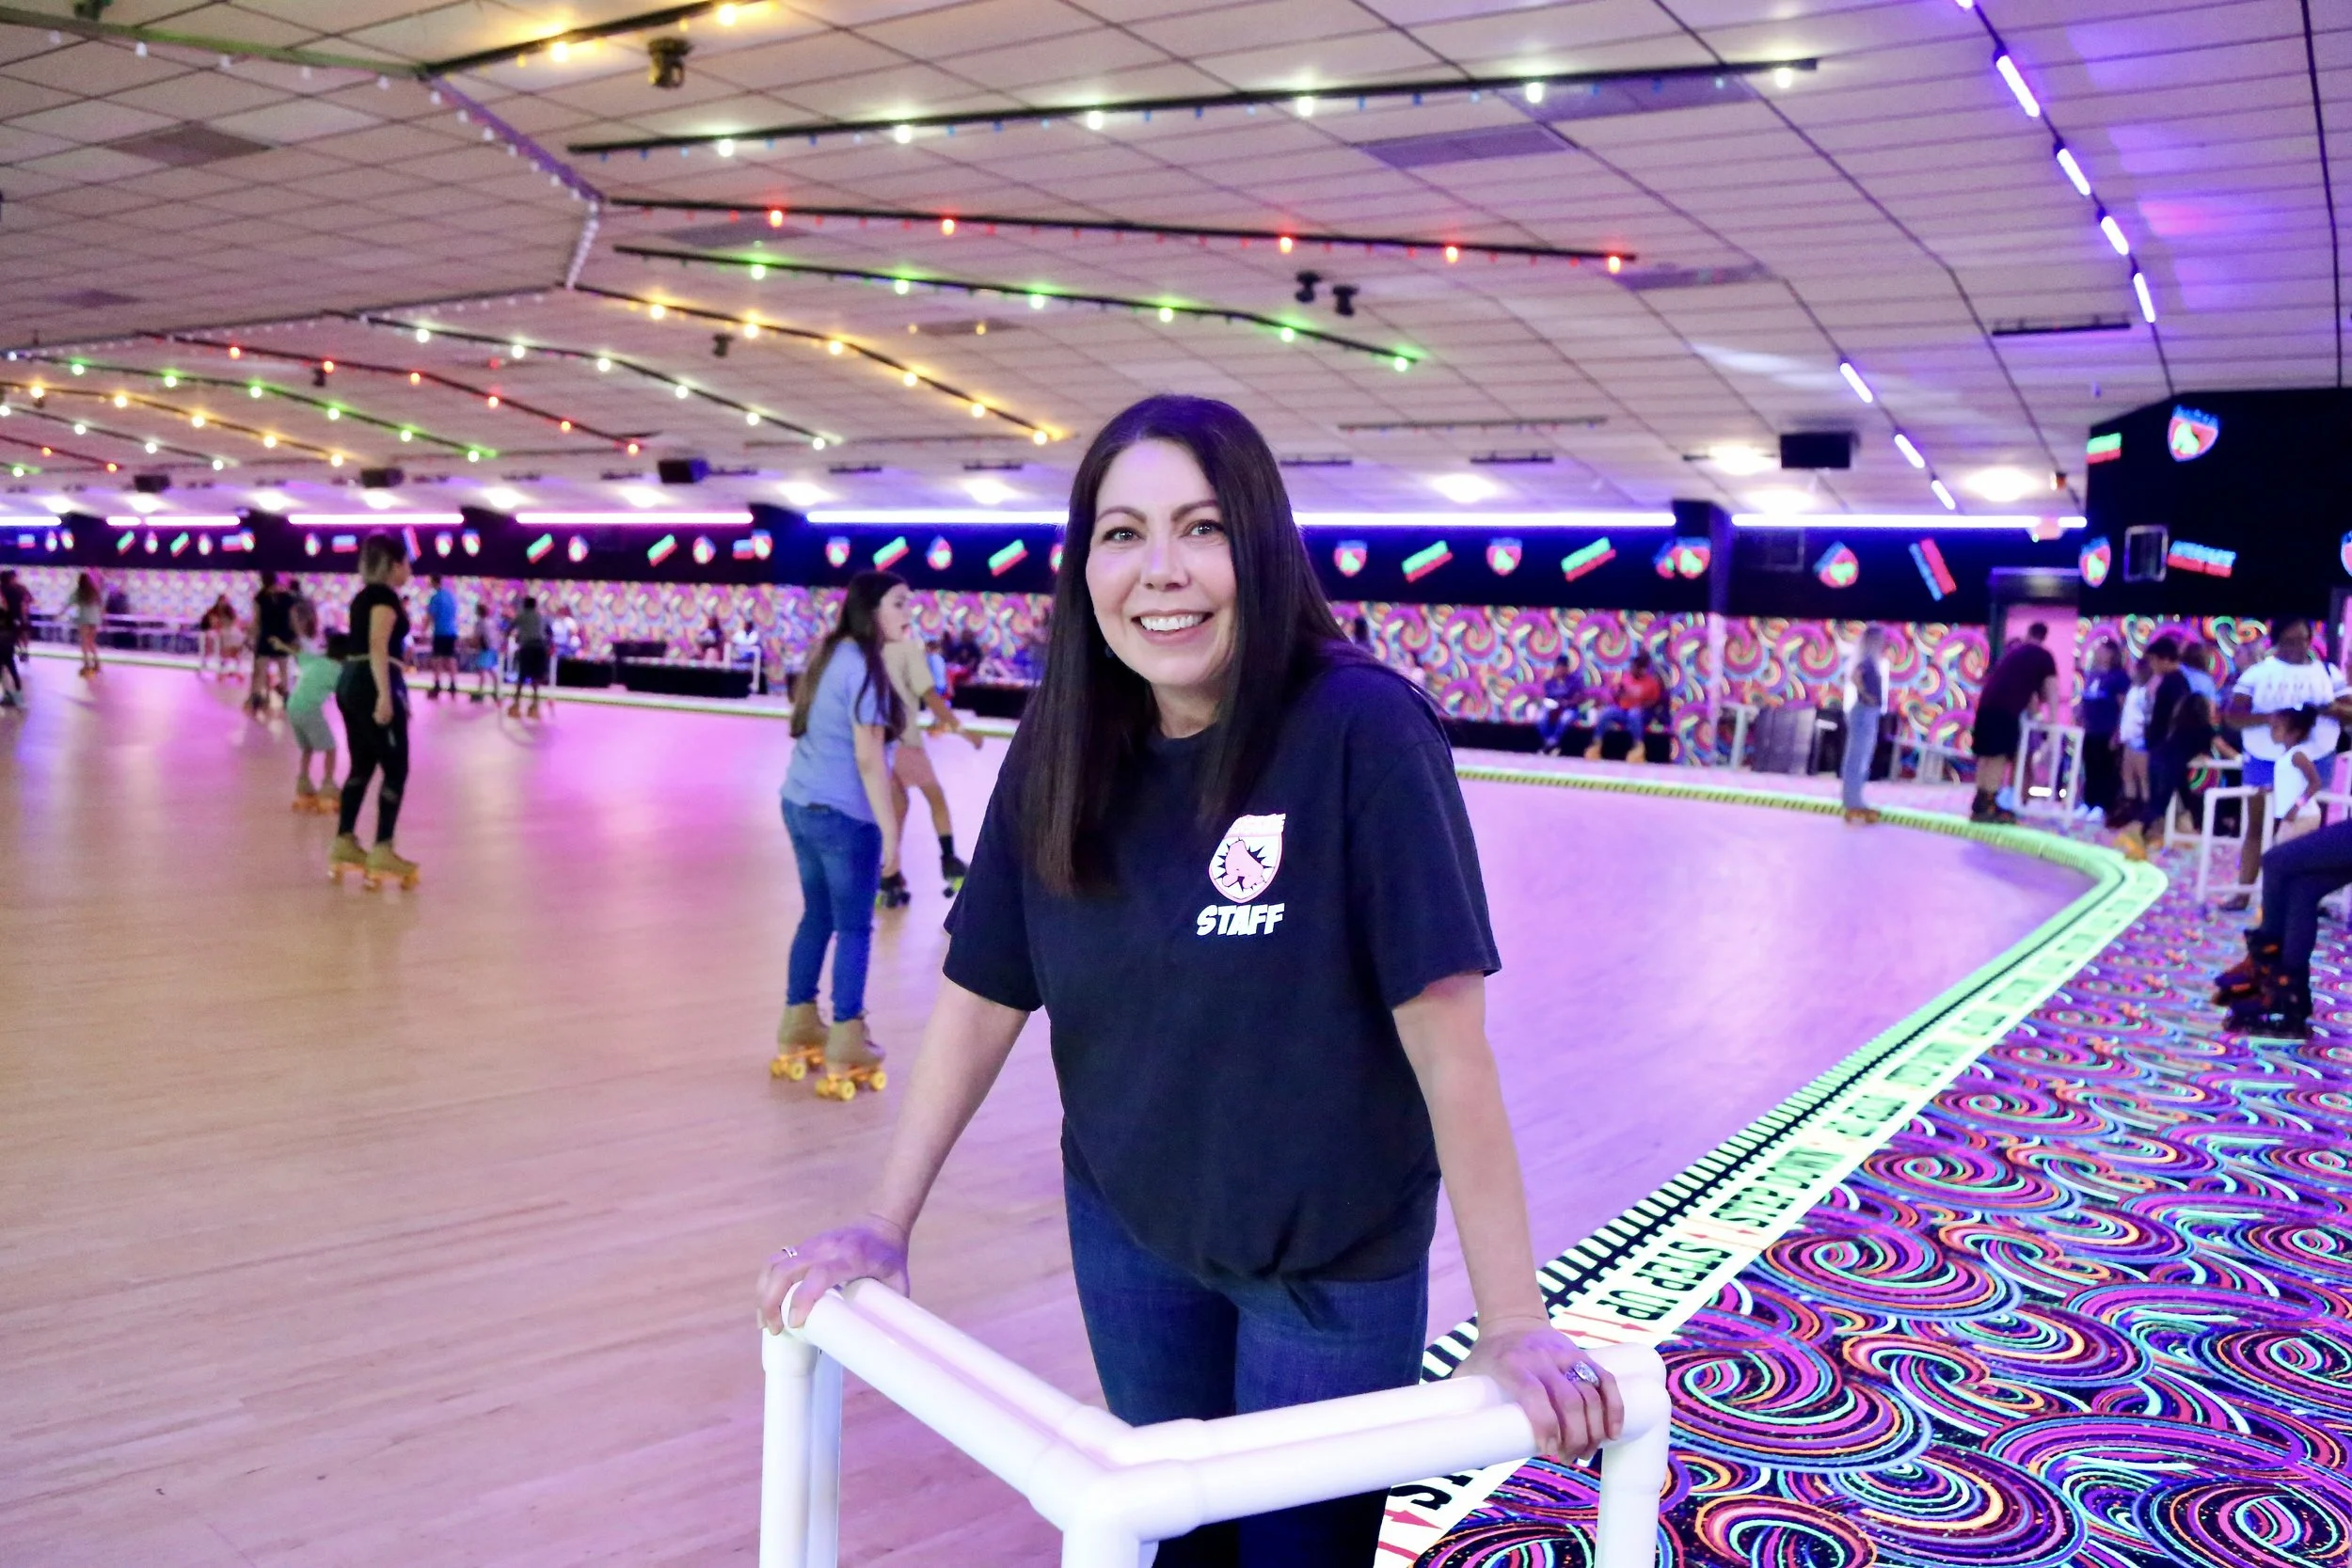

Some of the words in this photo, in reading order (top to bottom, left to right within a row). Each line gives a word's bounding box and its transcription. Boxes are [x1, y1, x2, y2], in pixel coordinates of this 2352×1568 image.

[1196, 902, 1285, 937] STAFF
[1709, 1186, 1795, 1227] STEP
[1632, 1241, 1732, 1291] STEP
[1596, 1290, 1679, 1321] UP
